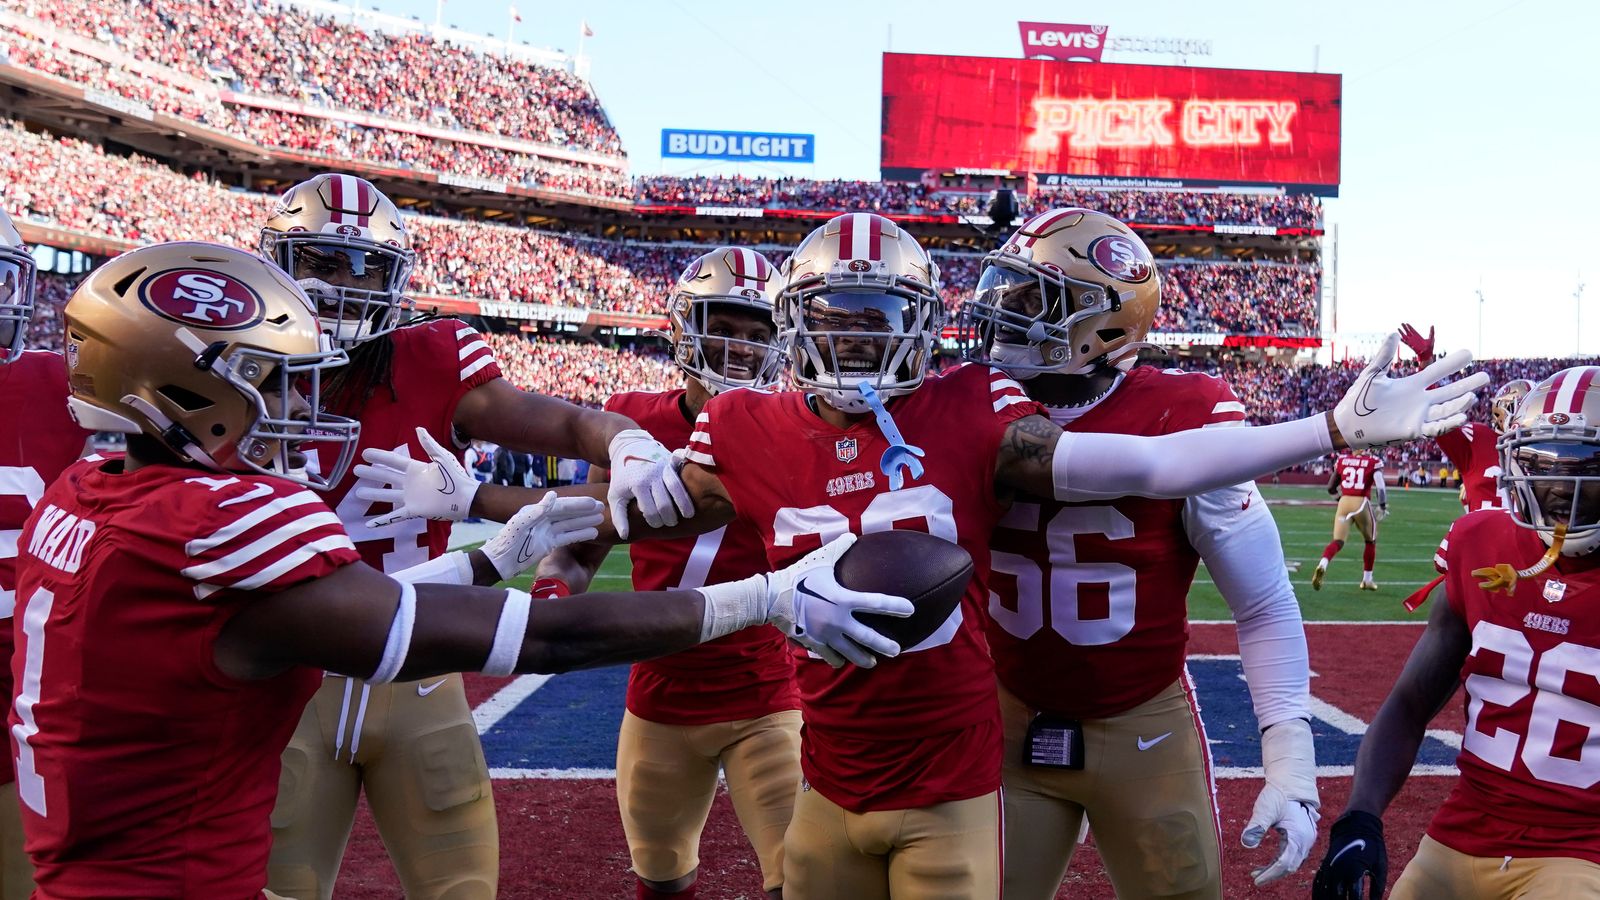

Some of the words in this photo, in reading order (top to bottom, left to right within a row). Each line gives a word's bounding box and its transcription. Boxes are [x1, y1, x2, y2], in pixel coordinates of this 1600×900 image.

[1111, 36, 1212, 56] STADIUM
[1028, 99, 1172, 147] PICK
[1183, 100, 1297, 144] CITY
[1061, 175, 1102, 186] Foxconn
[1102, 177, 1146, 187] Industrial
[1213, 225, 1277, 236] INTERCEPTION
[173, 273, 246, 323] SF
[478, 300, 589, 323] INTERCEPTION
[1145, 332, 1226, 346] ERCEPTION
[825, 471, 875, 497] 49ERS
[1341, 466, 1365, 490] 31
[988, 501, 1137, 646] 56
[1523, 612, 1570, 635] 49ERS
[12, 587, 55, 819] 1
[1464, 620, 1600, 789] 26
